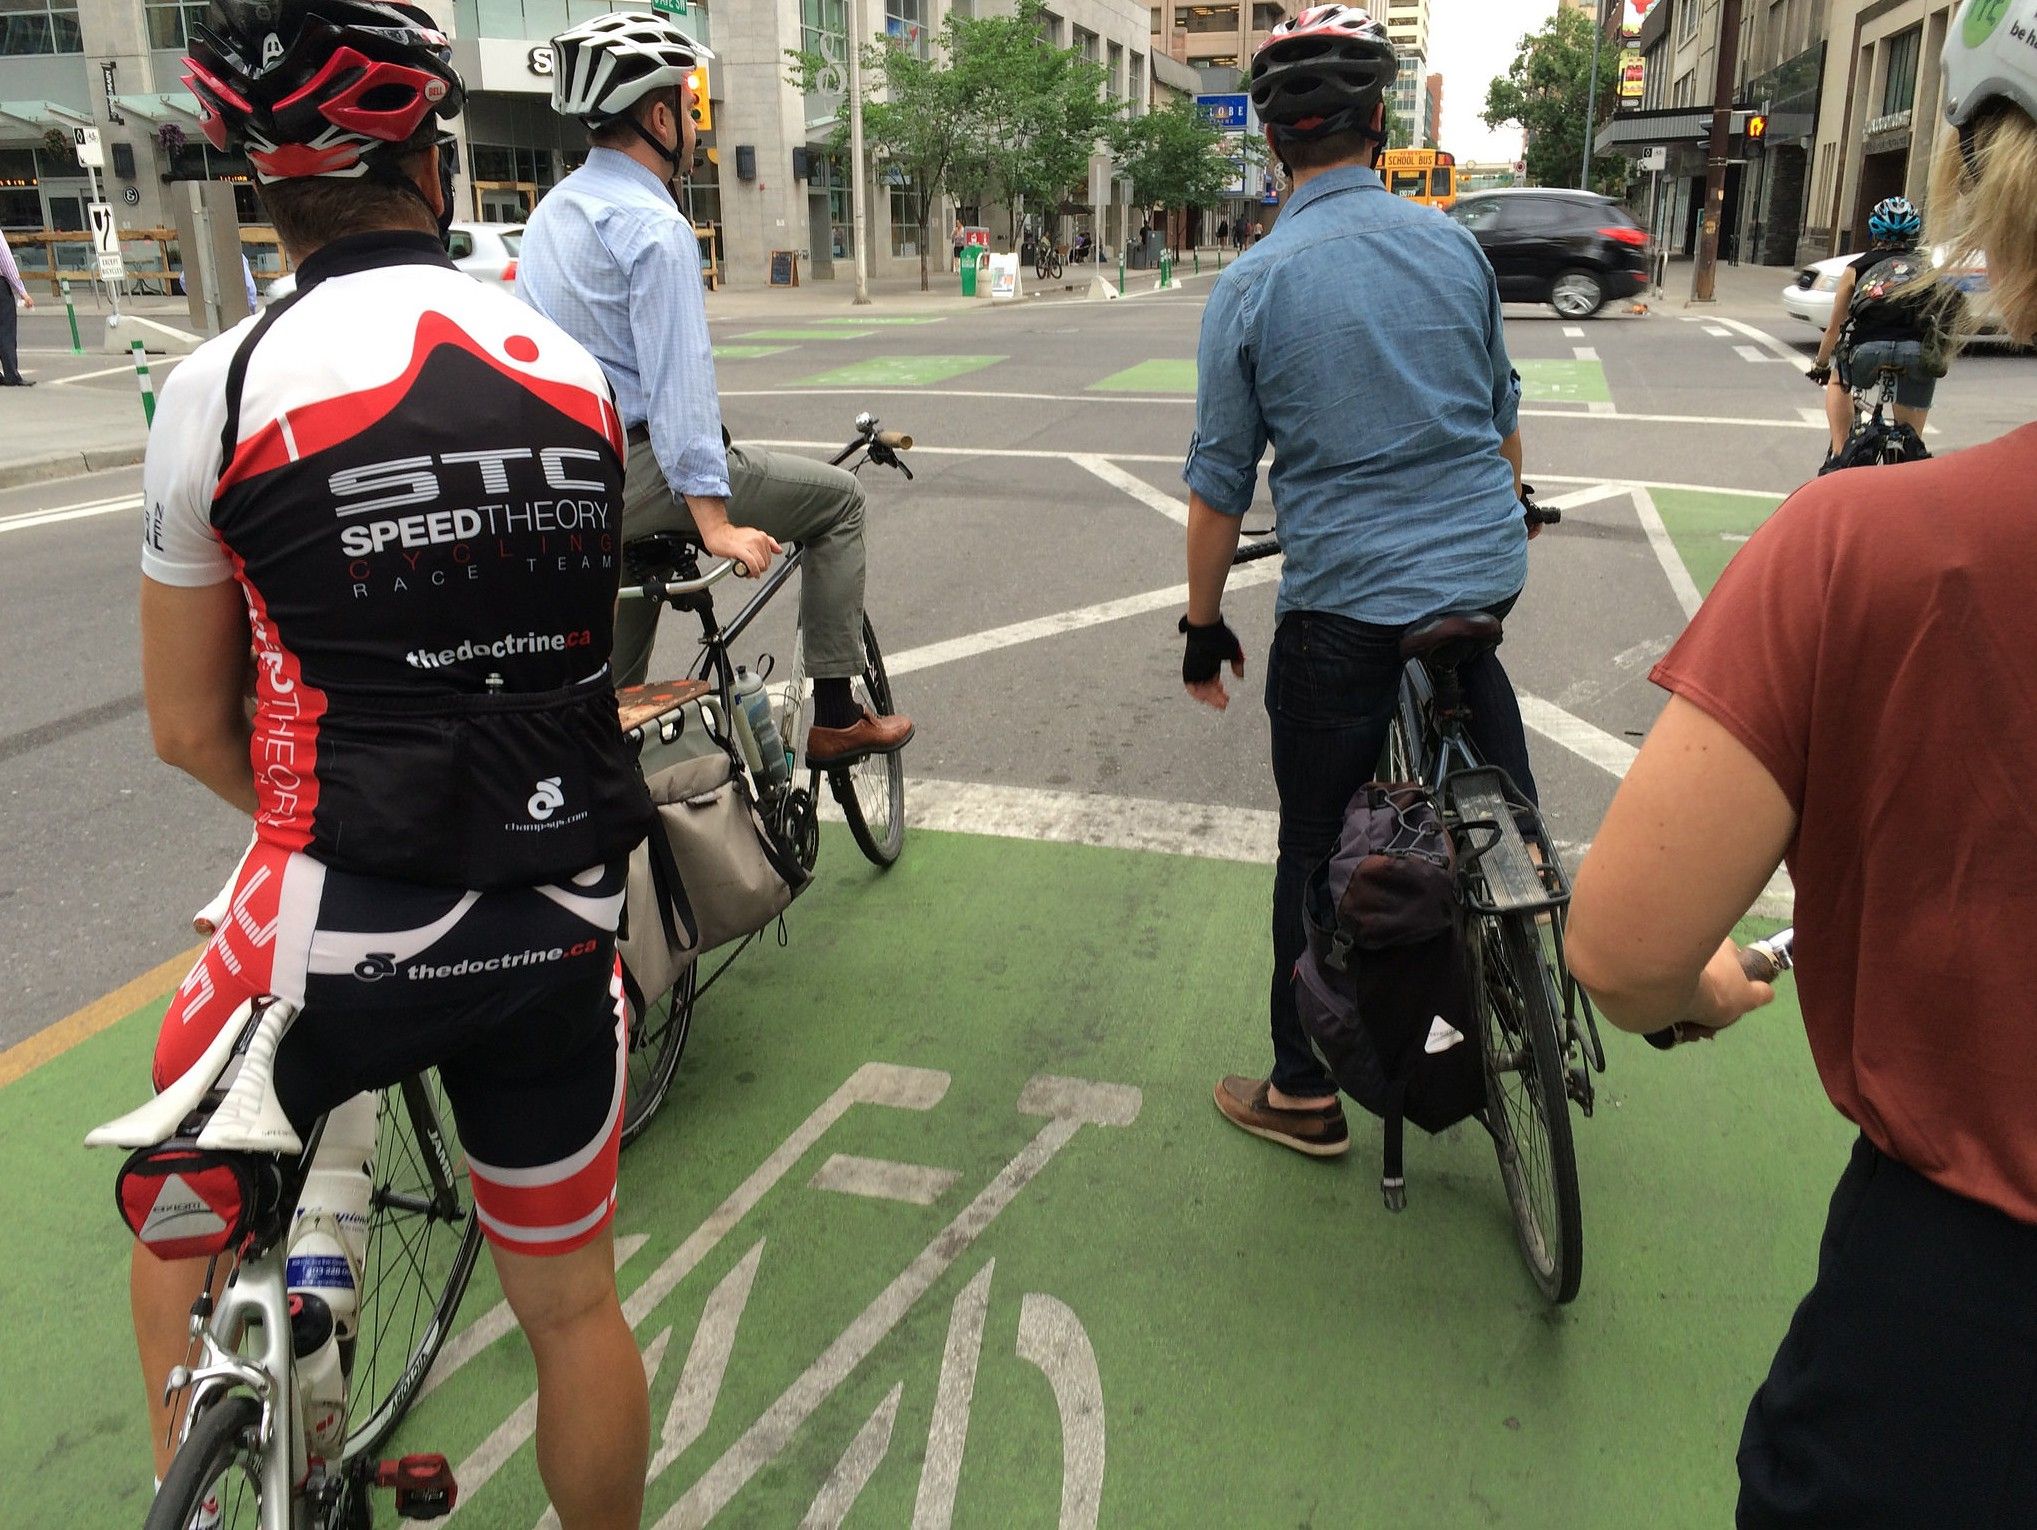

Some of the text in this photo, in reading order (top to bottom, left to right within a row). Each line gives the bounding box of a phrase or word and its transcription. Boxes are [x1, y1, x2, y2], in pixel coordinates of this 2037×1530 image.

[2010, 19, 2027, 41] be
[428, 87, 442, 96] BELL
[1388, 155, 1433, 165] SCHOOL BUS
[328, 447, 606, 518] STC
[340, 499, 609, 557] SPEEDTHEORY
[350, 534, 613, 580] CYCLING
[353, 555, 612, 598] RACE TEAM
[407, 937, 597, 981] thedoctrine.ca
[427, 1127, 455, 1188] JAMIS
